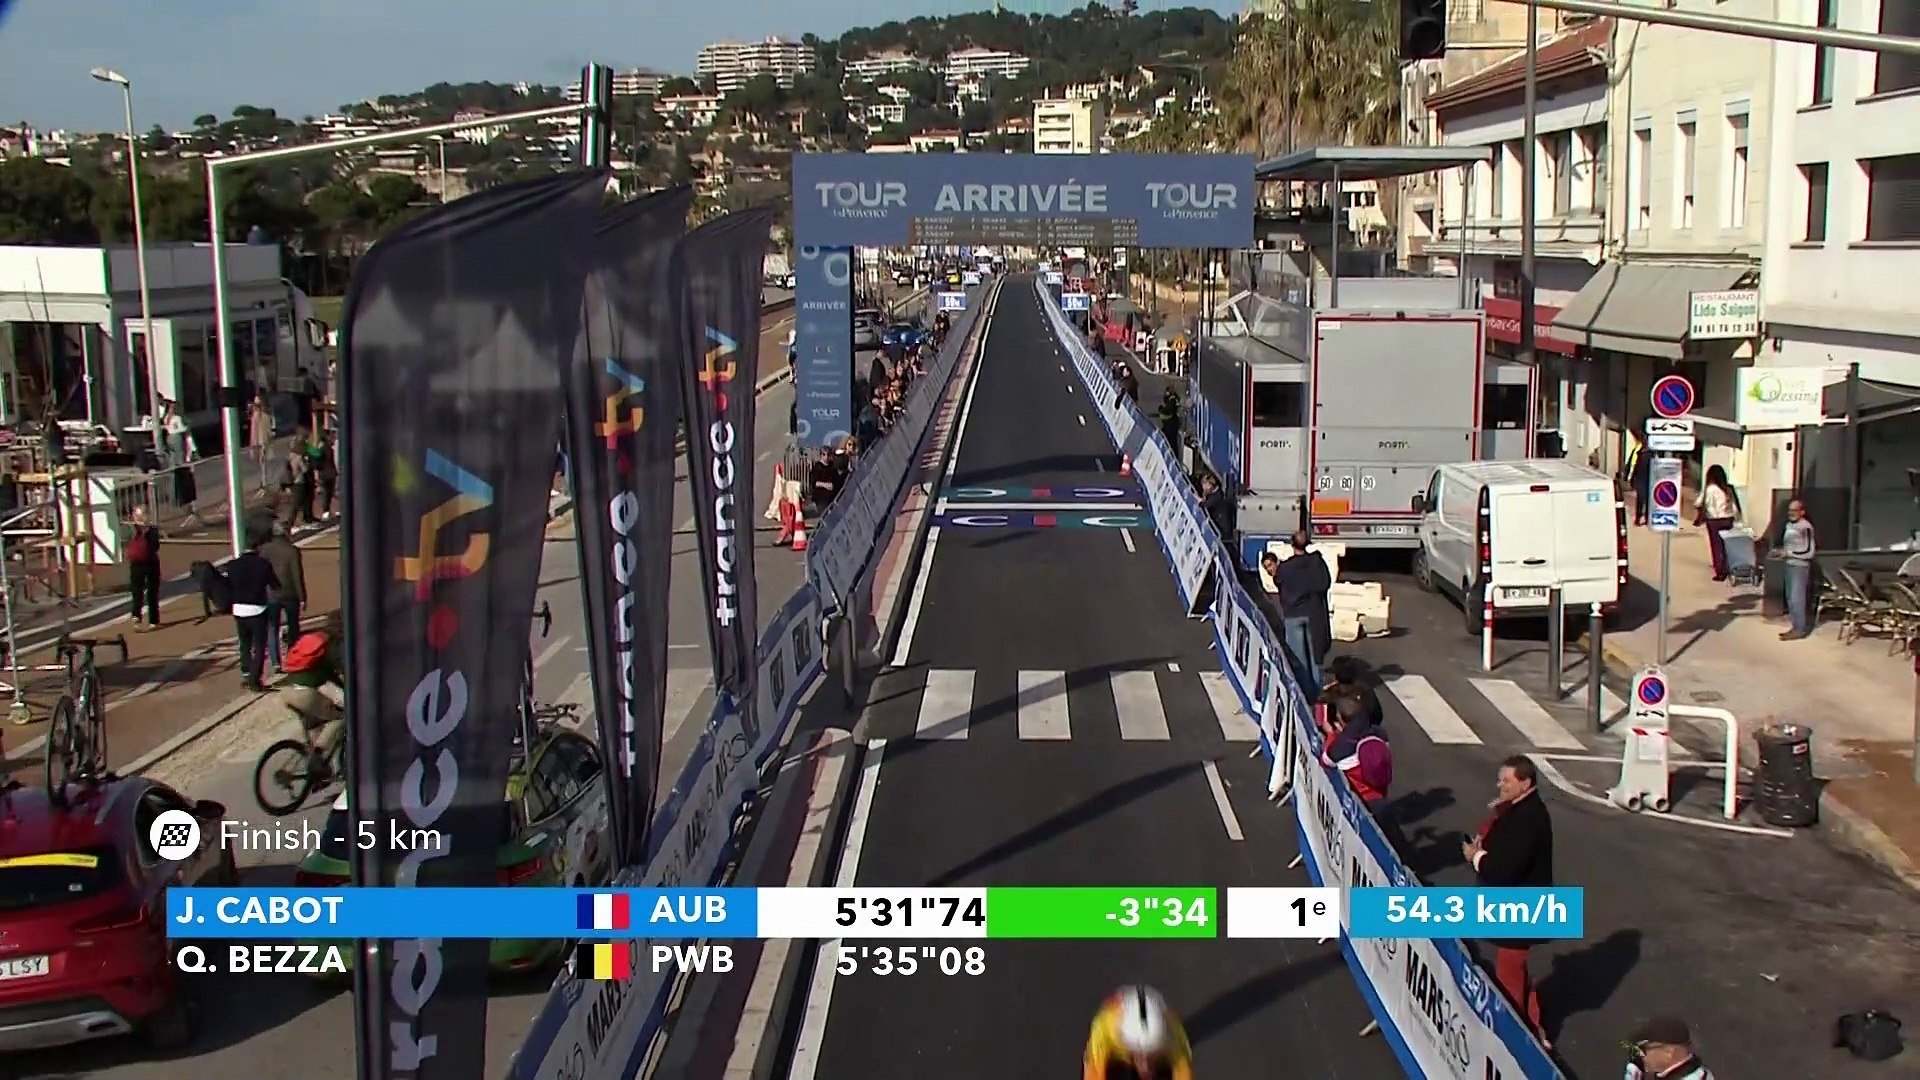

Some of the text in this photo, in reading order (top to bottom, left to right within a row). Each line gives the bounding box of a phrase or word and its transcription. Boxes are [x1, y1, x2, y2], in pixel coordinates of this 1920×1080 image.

[815, 178, 1237, 212] TOUR ARRIVÉE TOUR
[802, 301, 846, 310] ARRIVÉE
[1694, 302, 1756, 318] Lido Saigon
[812, 407, 841, 418] TOUR
[1320, 477, 1331, 489] 60
[1341, 477, 1352, 489] 80
